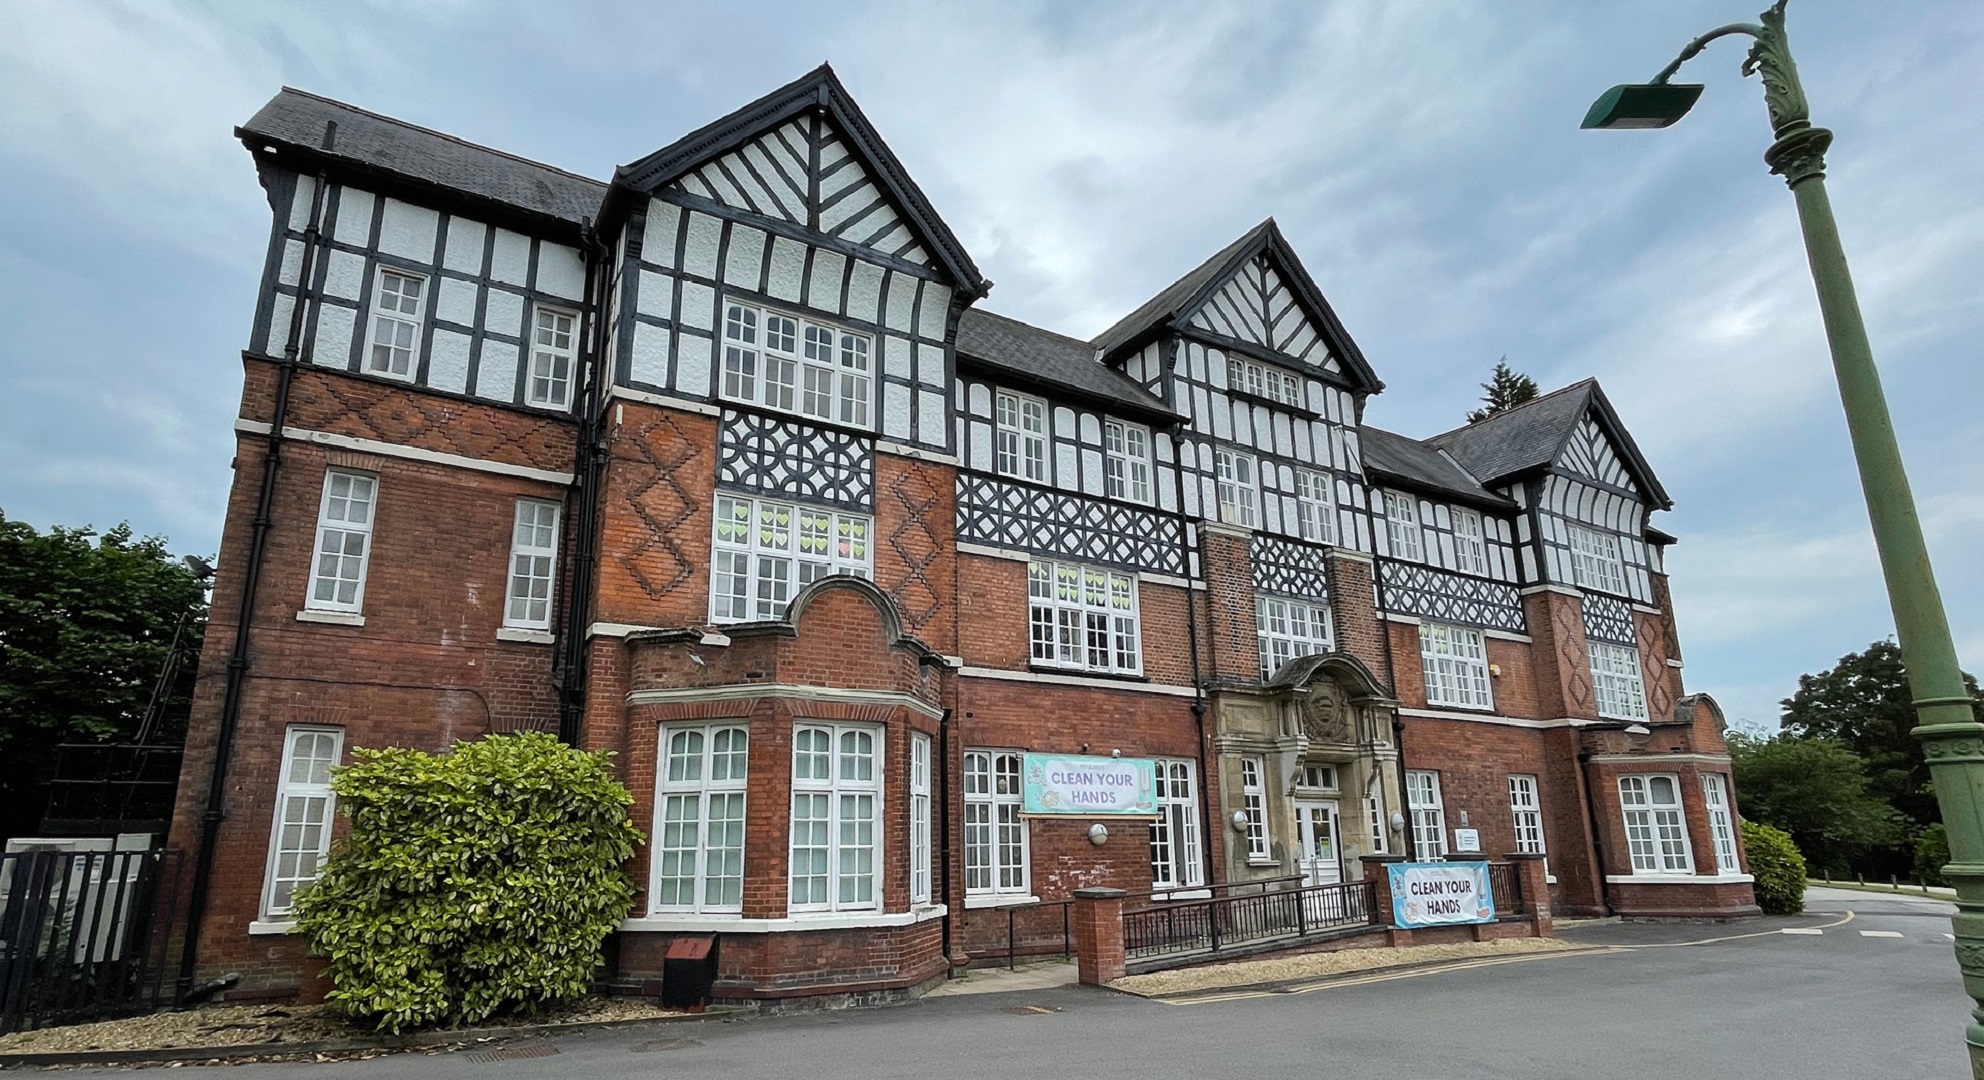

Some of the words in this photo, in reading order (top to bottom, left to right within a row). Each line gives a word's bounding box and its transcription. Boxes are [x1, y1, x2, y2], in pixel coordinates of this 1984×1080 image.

[1051, 772, 1093, 785] CLEAN
[1096, 773, 1133, 786] YOUR
[1072, 791, 1116, 804] HANDS
[1411, 881, 1443, 895] CLEAN
[1445, 880, 1472, 894] YOUR
[1427, 899, 1461, 915] HANDS
